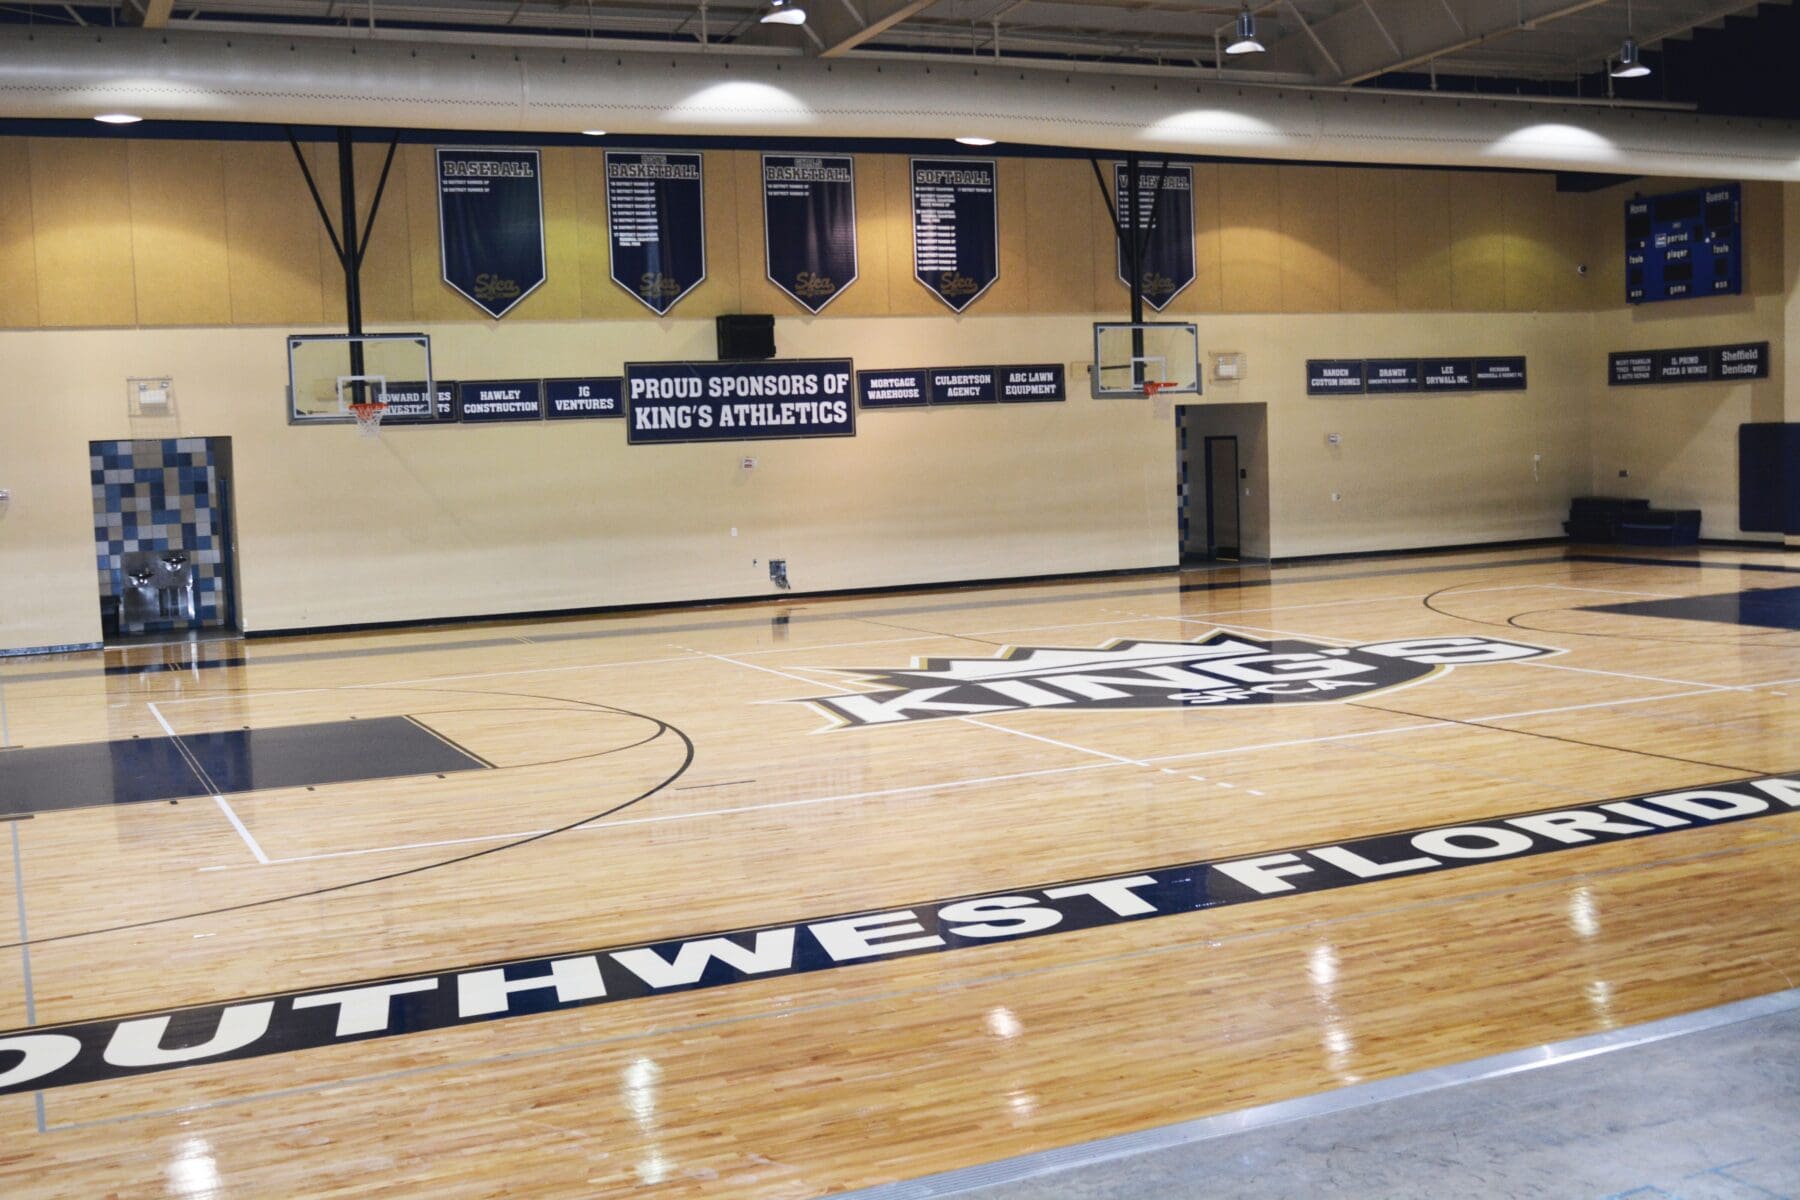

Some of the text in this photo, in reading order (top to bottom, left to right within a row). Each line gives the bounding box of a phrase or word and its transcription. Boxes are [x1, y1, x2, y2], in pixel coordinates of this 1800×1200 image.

[444, 160, 534, 178] BASEBALL
[609, 163, 700, 180] BASKETBALL
[766, 166, 851, 182] BASKETBALL
[916, 170, 990, 184] SOFTBALL
[1119, 174, 1189, 190] VLEYALL
[1441, 366, 1454, 374] LEE
[1722, 364, 1758, 375] Dentistry
[870, 378, 915, 388] MORTGAGE
[935, 374, 991, 386] CULBERTSON
[1009, 372, 1054, 382] ABC LAWN
[630, 374, 849, 399] PROUD SPONSORS OF
[947, 387, 980, 397] AGENCY
[1006, 384, 1056, 395] EQUIPMENT
[422, 392, 451, 401] JOES
[480, 390, 520, 400] HAWLEY
[868, 389, 919, 399] WAREHOUSE
[464, 402, 538, 414] CONSTRUCTION
[555, 399, 614, 410] VENTURES
[635, 401, 848, 429] KING'S ATHLETICS
[825, 637, 1542, 723] KING'S
[1166, 679, 1377, 704] SFCA
